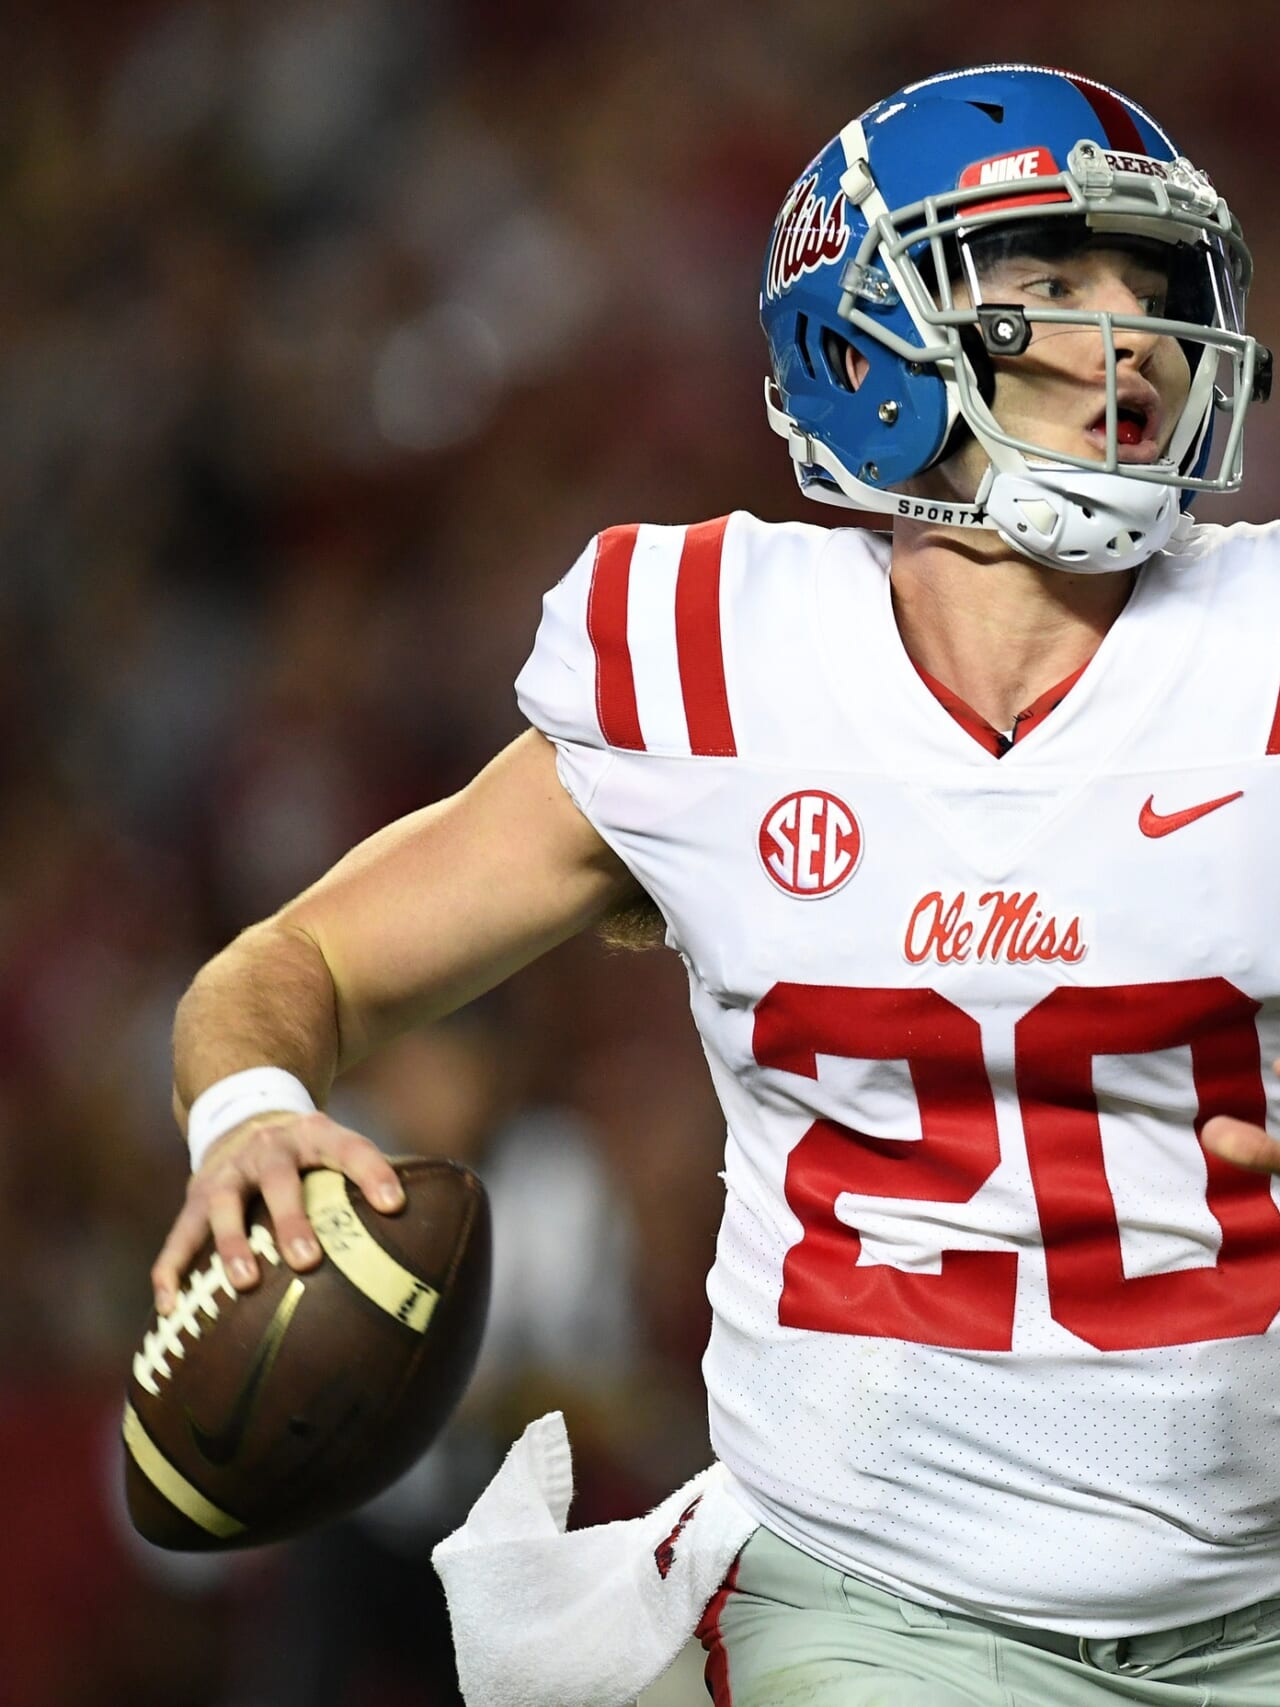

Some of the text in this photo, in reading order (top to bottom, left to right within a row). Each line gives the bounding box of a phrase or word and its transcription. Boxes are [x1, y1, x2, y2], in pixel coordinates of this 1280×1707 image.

[980, 151, 1040, 185] NIKE
[1105, 154, 1167, 180] REBS
[765, 795, 853, 889] SEC
[905, 891, 1086, 962] Ole Miss
